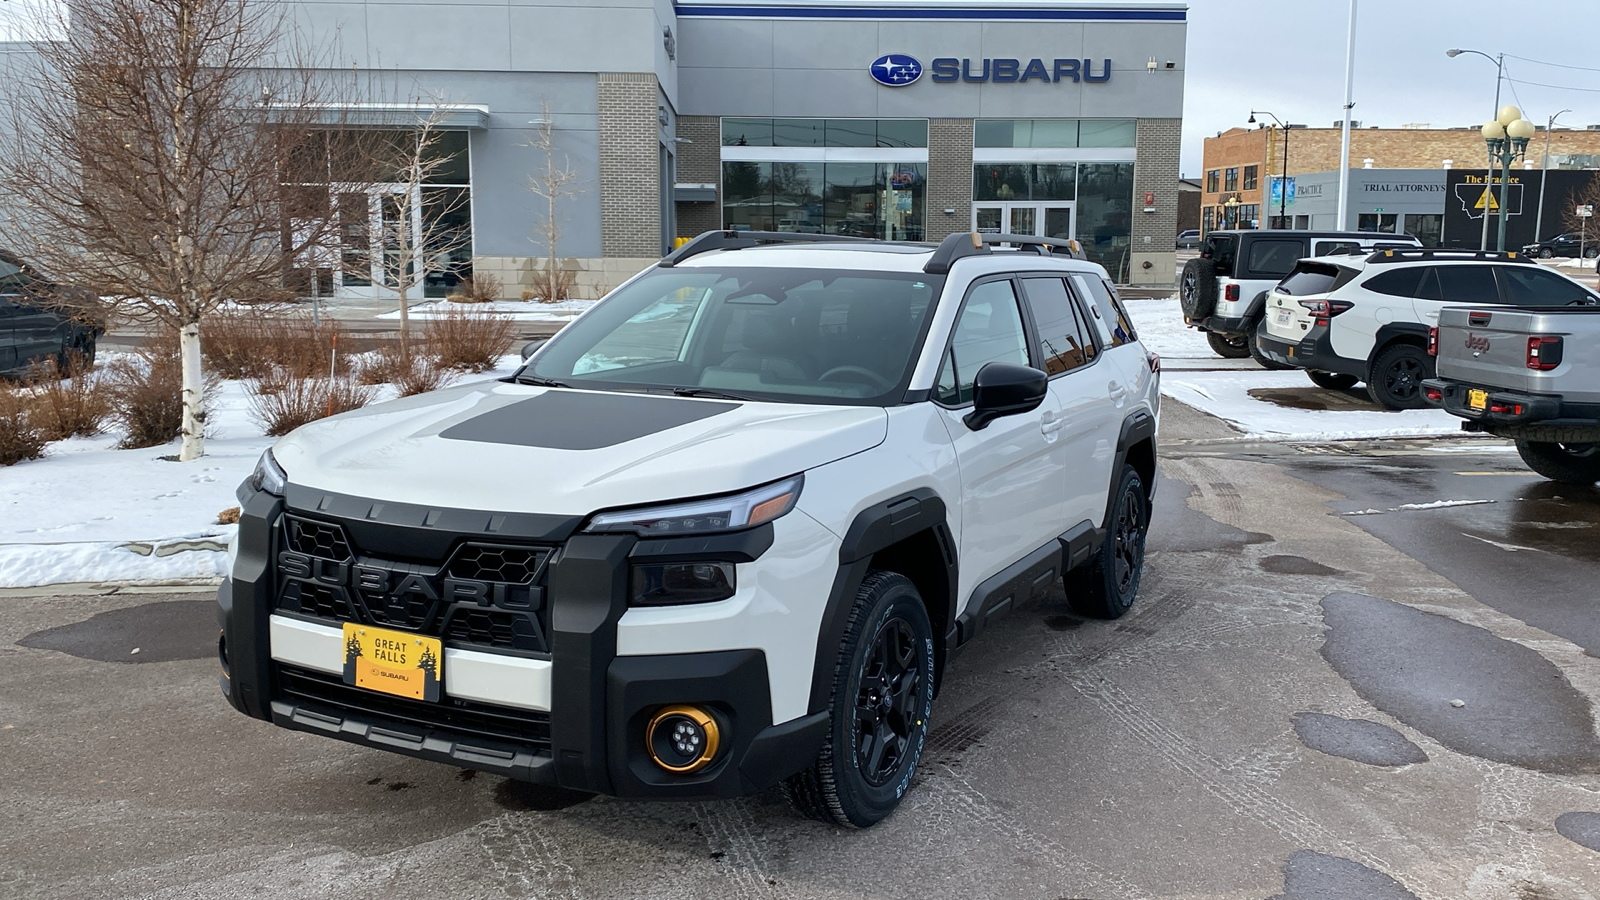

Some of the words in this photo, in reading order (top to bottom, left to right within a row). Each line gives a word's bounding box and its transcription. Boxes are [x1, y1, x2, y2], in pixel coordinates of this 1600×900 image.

[931, 57, 1112, 83] SUBARU
[1464, 174, 1482, 184] The
[1484, 174, 1520, 184] Pracice
[1297, 184, 1323, 196] PRACTICE
[1363, 184, 1392, 192] TRIAL
[1393, 184, 1446, 192] ATTORNEYS
[1465, 333, 1491, 354] Jeep
[278, 550, 545, 612] SUBARU
[374, 638, 407, 653] GREAT
[374, 648, 407, 665] FALLS
[380, 671, 410, 682] SUBARU
[896, 638, 935, 799] BRIDGESTONE
